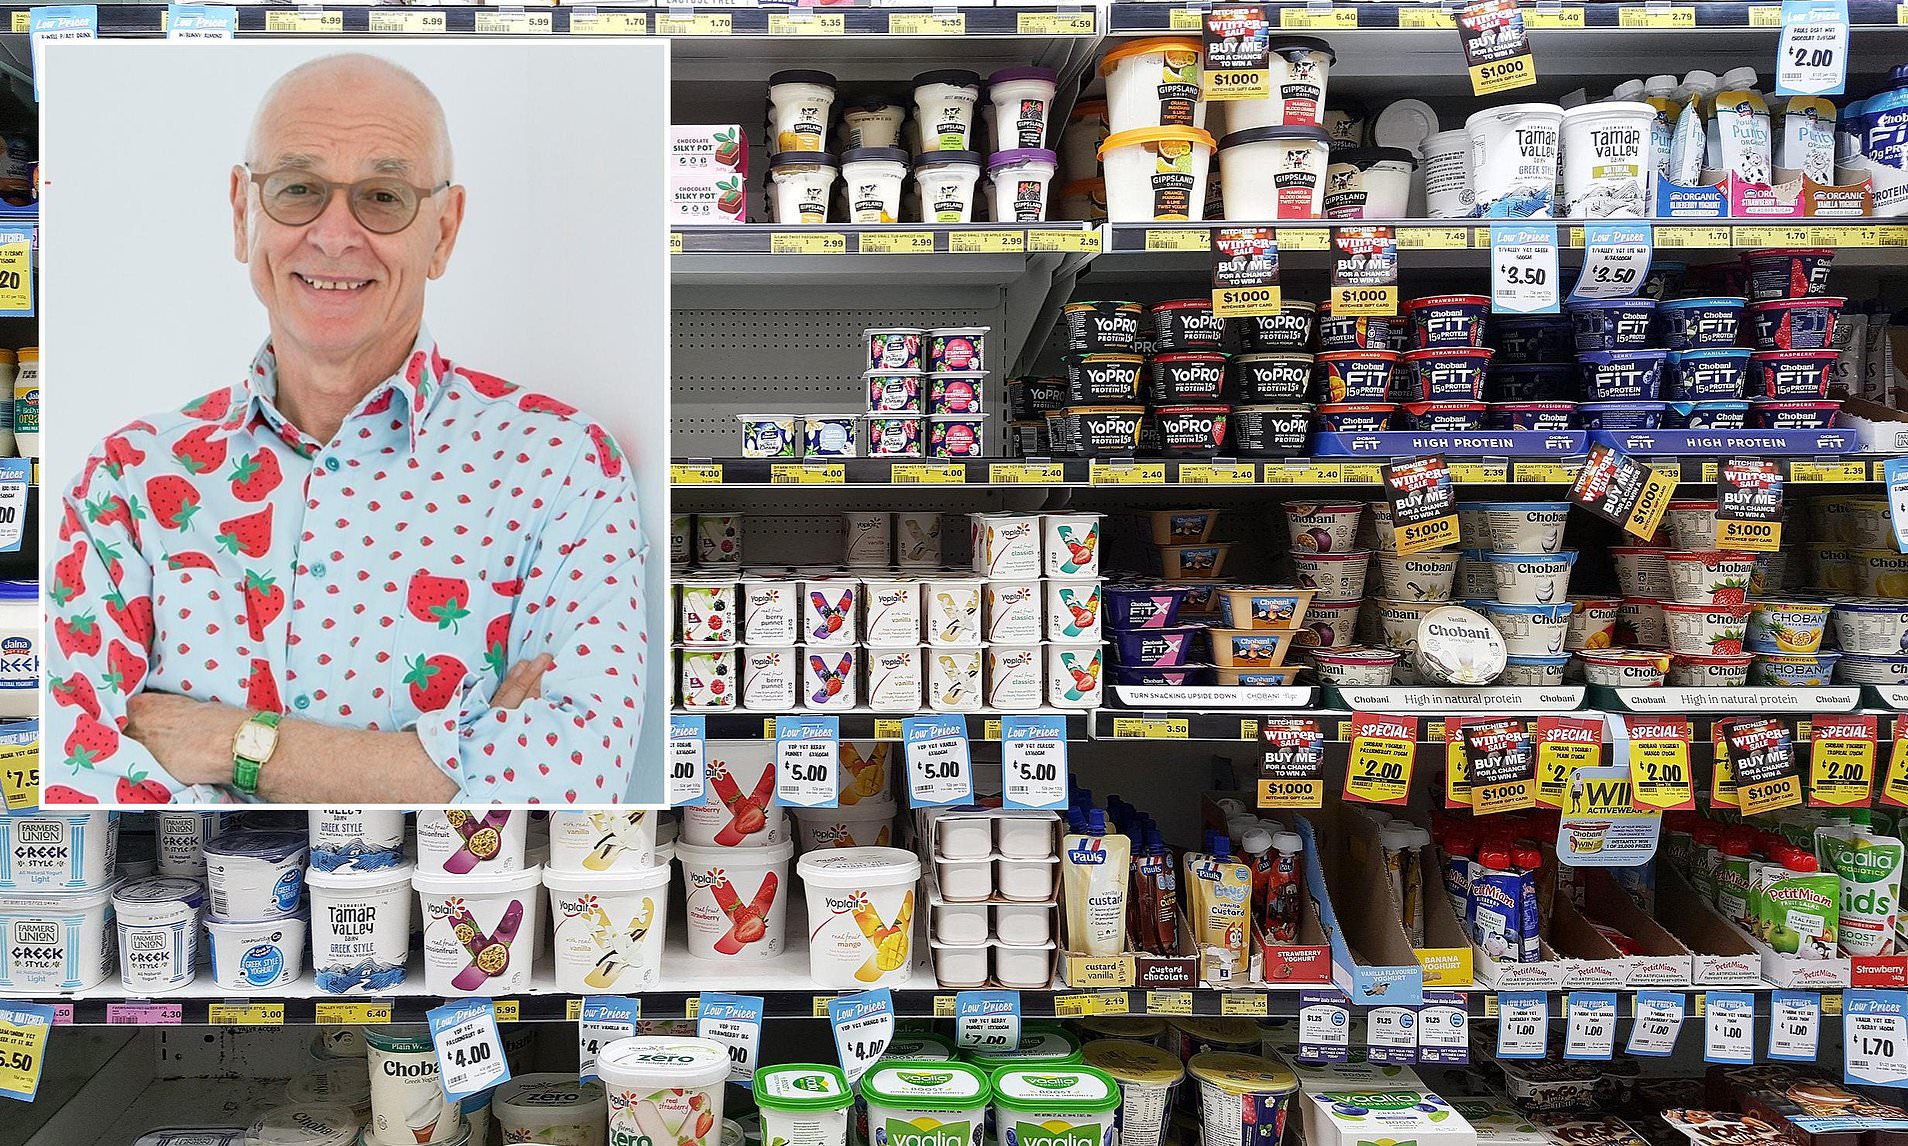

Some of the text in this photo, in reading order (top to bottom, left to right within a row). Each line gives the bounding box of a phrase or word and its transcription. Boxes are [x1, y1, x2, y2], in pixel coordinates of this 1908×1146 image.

[320, 16, 341, 24] 6.99
[422, 17, 444, 25] 5.99
[625, 18, 645, 26] 1.70
[1070, 20, 1091, 28] 4.59
[1481, 61, 1524, 78] $1,000
[1214, 74, 1259, 85] $1,000
[1283, 86, 1320, 95] GIPPSLAND
[673, 144, 713, 152] SILKY POT
[1153, 175, 1193, 184] GIPPSLAND
[1325, 193, 1365, 205] GIPPSLAND
[1497, 232, 1550, 243] Low Prices
[1708, 232, 1728, 240] 1.70
[1338, 259, 1390, 269] BUY ME
[1224, 291, 1269, 303] $1,000
[1342, 291, 1387, 302] $1,000
[1087, 369, 1135, 384] YoPRO
[1171, 368, 1219, 382] YoPRO
[1253, 368, 1302, 382] YoPRO
[1162, 419, 1211, 434] YoPRO
[1413, 438, 1513, 448] HIGH PROTEIN
[943, 469, 962, 477] 4.00
[1844, 467, 1863, 475] 2.39
[1396, 491, 1448, 509] BUY ME
[1634, 483, 1659, 525] $1,000
[1725, 494, 1776, 504] BUY ME
[1405, 522, 1448, 539] $1,000
[1728, 524, 1770, 536] $1,000
[1428, 624, 1490, 639] Chobani
[1405, 695, 1430, 705] High
[1432, 695, 1442, 703] in
[1445, 695, 1481, 704] natural
[1484, 695, 1522, 705] protein
[1631, 696, 1665, 704] Chobani
[1681, 695, 1706, 705] High
[1721, 695, 1758, 703] natural
[1760, 695, 1797, 705] protein
[781, 726, 833, 737] Low Prices
[1008, 726, 1059, 737] Low Prices
[1361, 724, 1409, 739] SPECIAL
[1547, 730, 1593, 741] SPECIAL
[1821, 726, 1868, 738] SPECIAL
[1266, 753, 1316, 762] BUY ME
[1269, 784, 1312, 794] $1,000
[1483, 785, 1525, 800] $1,000
[1749, 782, 1790, 800] $1,000
[22, 824, 59, 832] FARMERS
[22, 831, 59, 840] UNION
[15, 847, 67, 858] GREEK
[1073, 852, 1103, 862] Pauls
[1200, 871, 1219, 879] Pauls
[1838, 866, 1885, 876] PROBIOTICS
[31, 875, 49, 883] Light
[1089, 894, 1122, 906] custard
[1769, 889, 1832, 907] PetitMiam
[1212, 908, 1245, 916] Custard
[331, 943, 373, 953] GREEK STYLE
[1150, 966, 1182, 974] Custard
[1856, 965, 1904, 975] Strawberry
[836, 1000, 886, 1020] Low Prices
[962, 1001, 1012, 1013] Low Prices
[1849, 1000, 1901, 1013] Low Prices
[435, 1004, 486, 1030] Low Prices
